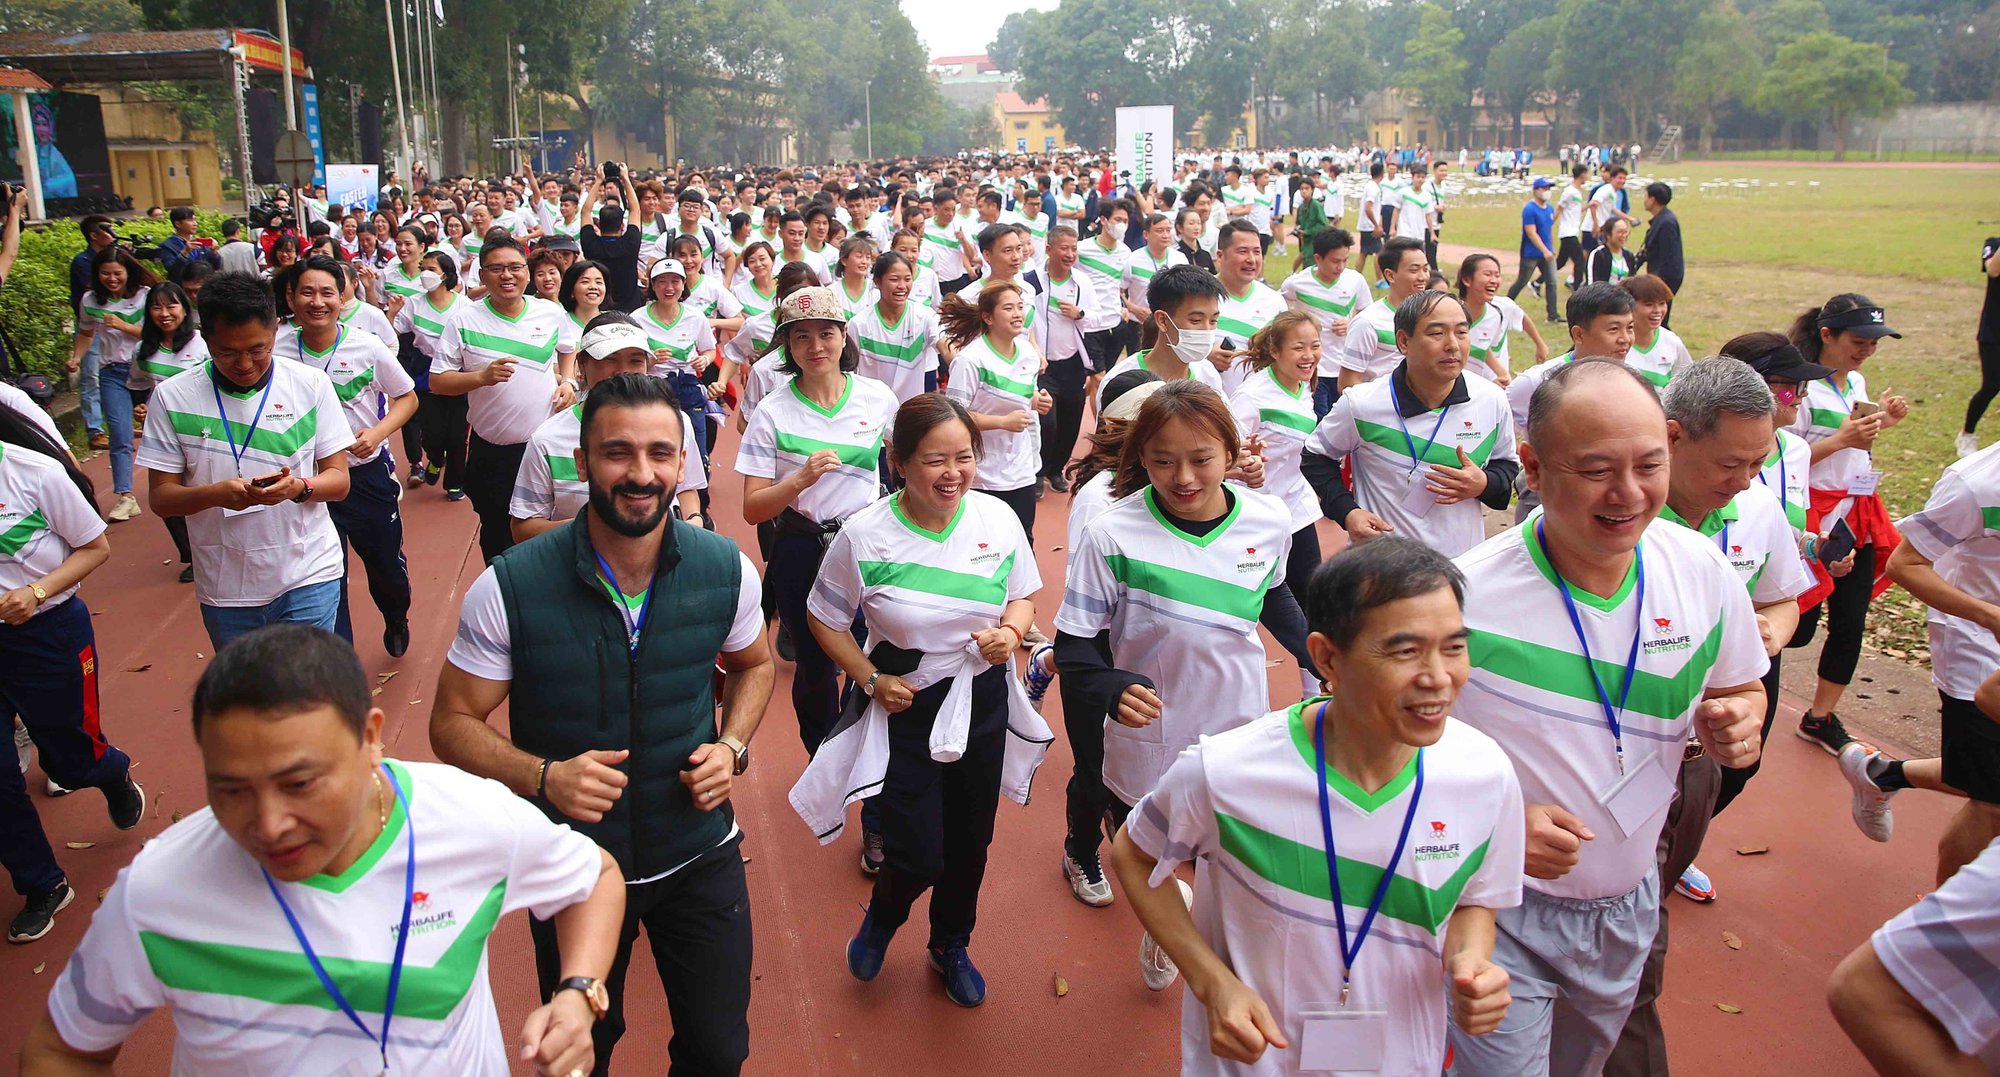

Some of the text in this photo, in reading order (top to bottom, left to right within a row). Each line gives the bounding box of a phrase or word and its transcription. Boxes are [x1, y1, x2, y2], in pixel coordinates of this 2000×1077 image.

[970, 552, 1001, 562] HERBALIFE
[1237, 560, 1266, 569] HERBALIFE
[1643, 635, 1691, 649] HERBALIFE
[1644, 642, 1692, 655] NUTRITION
[1415, 843, 1460, 854] HERBALIFE
[1415, 851, 1460, 862] NUTRITION
[390, 910, 454, 933] HRBALIFE
[392, 918, 457, 940] NTRITION
